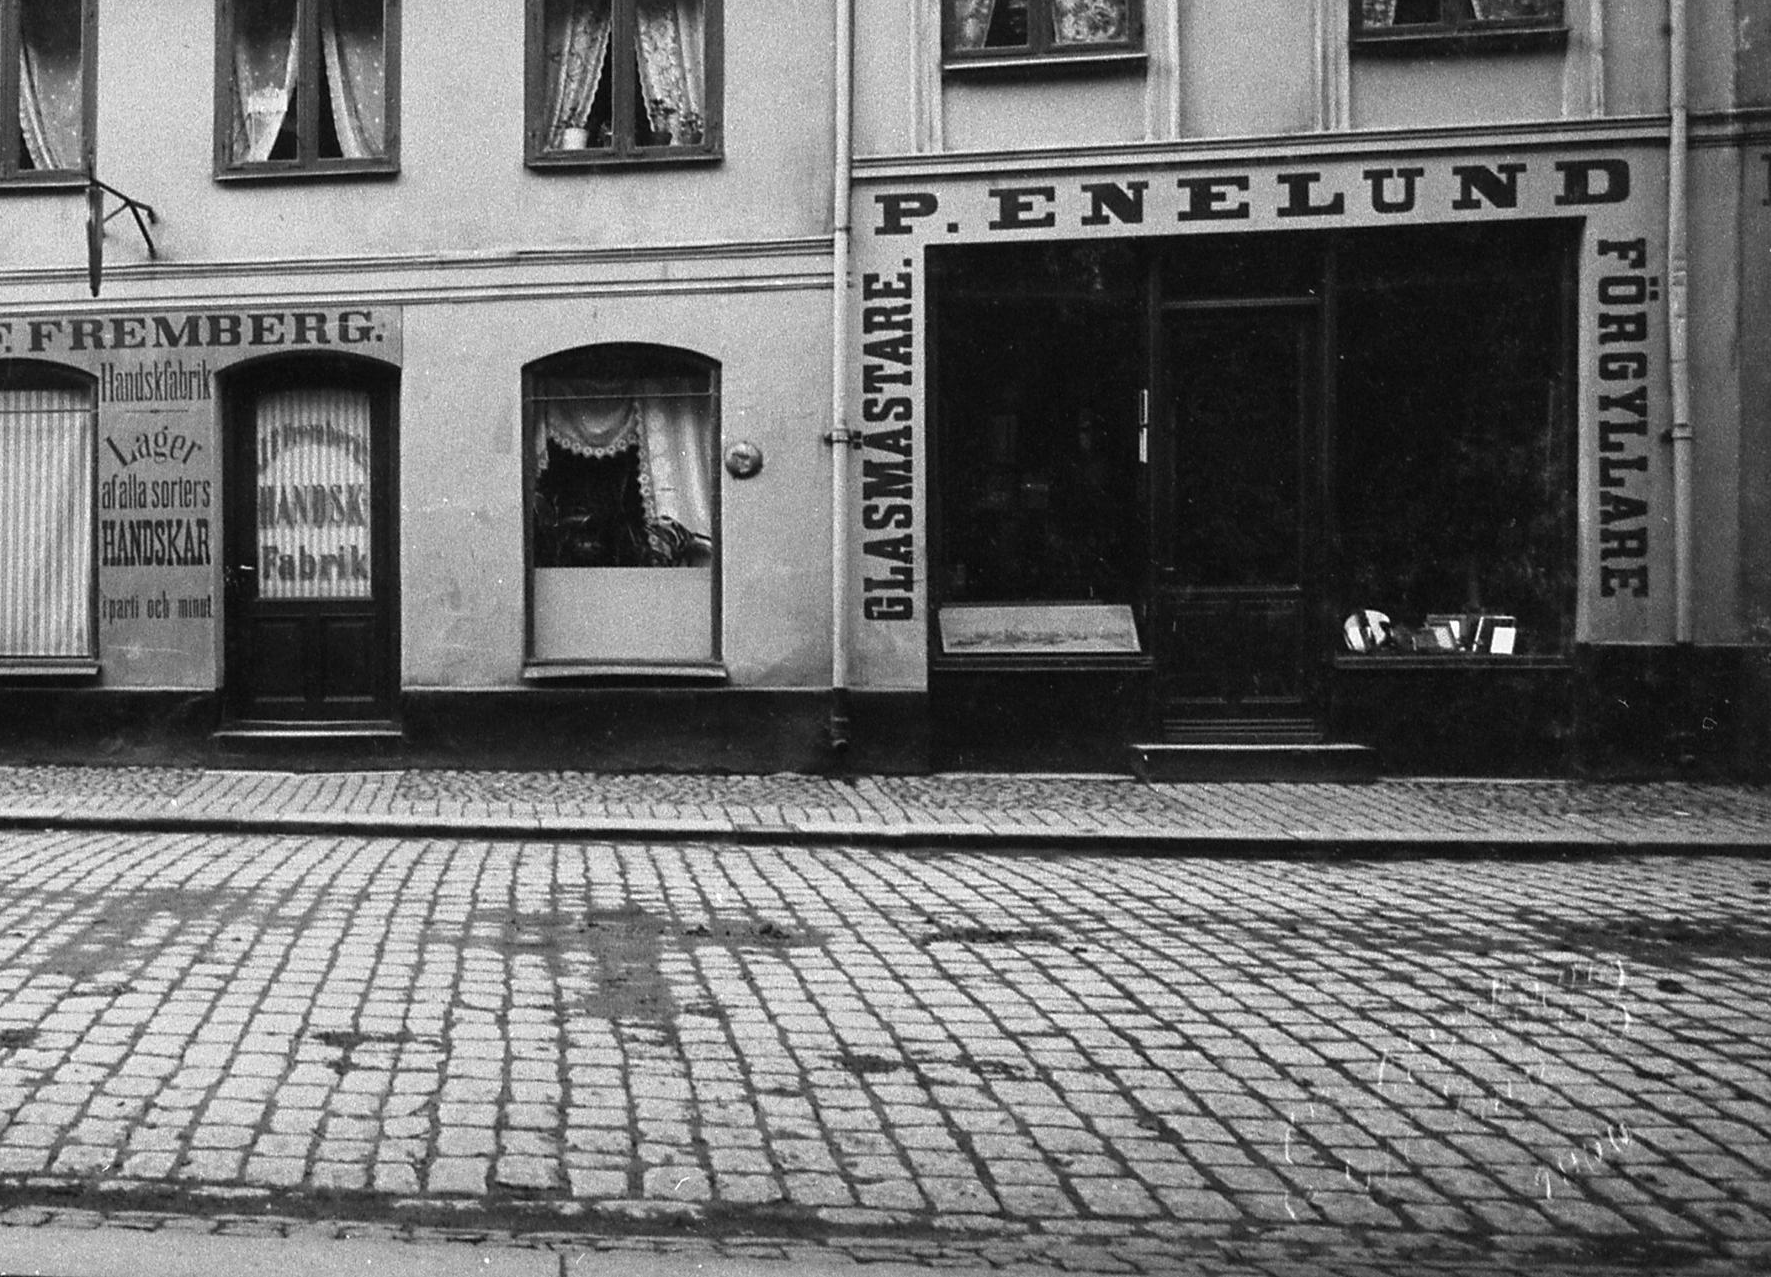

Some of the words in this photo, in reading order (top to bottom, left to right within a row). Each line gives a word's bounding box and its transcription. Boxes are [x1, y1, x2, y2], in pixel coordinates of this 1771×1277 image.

[875, 191, 959, 236] P.
[989, 158, 1632, 231] ENELUND
[27, 310, 384, 351] FREMBERG.
[101, 362, 214, 403] Handskfabrik
[1597, 237, 1659, 599] FÖRGYLLARE
[106, 425, 203, 467] Lager
[119, 474, 147, 509] alla
[151, 478, 211, 509] sorters
[101, 519, 211, 566] HANDSKAR
[262, 546, 369, 581] Fabrik
[109, 595, 139, 625] parti
[147, 590, 170, 619] och
